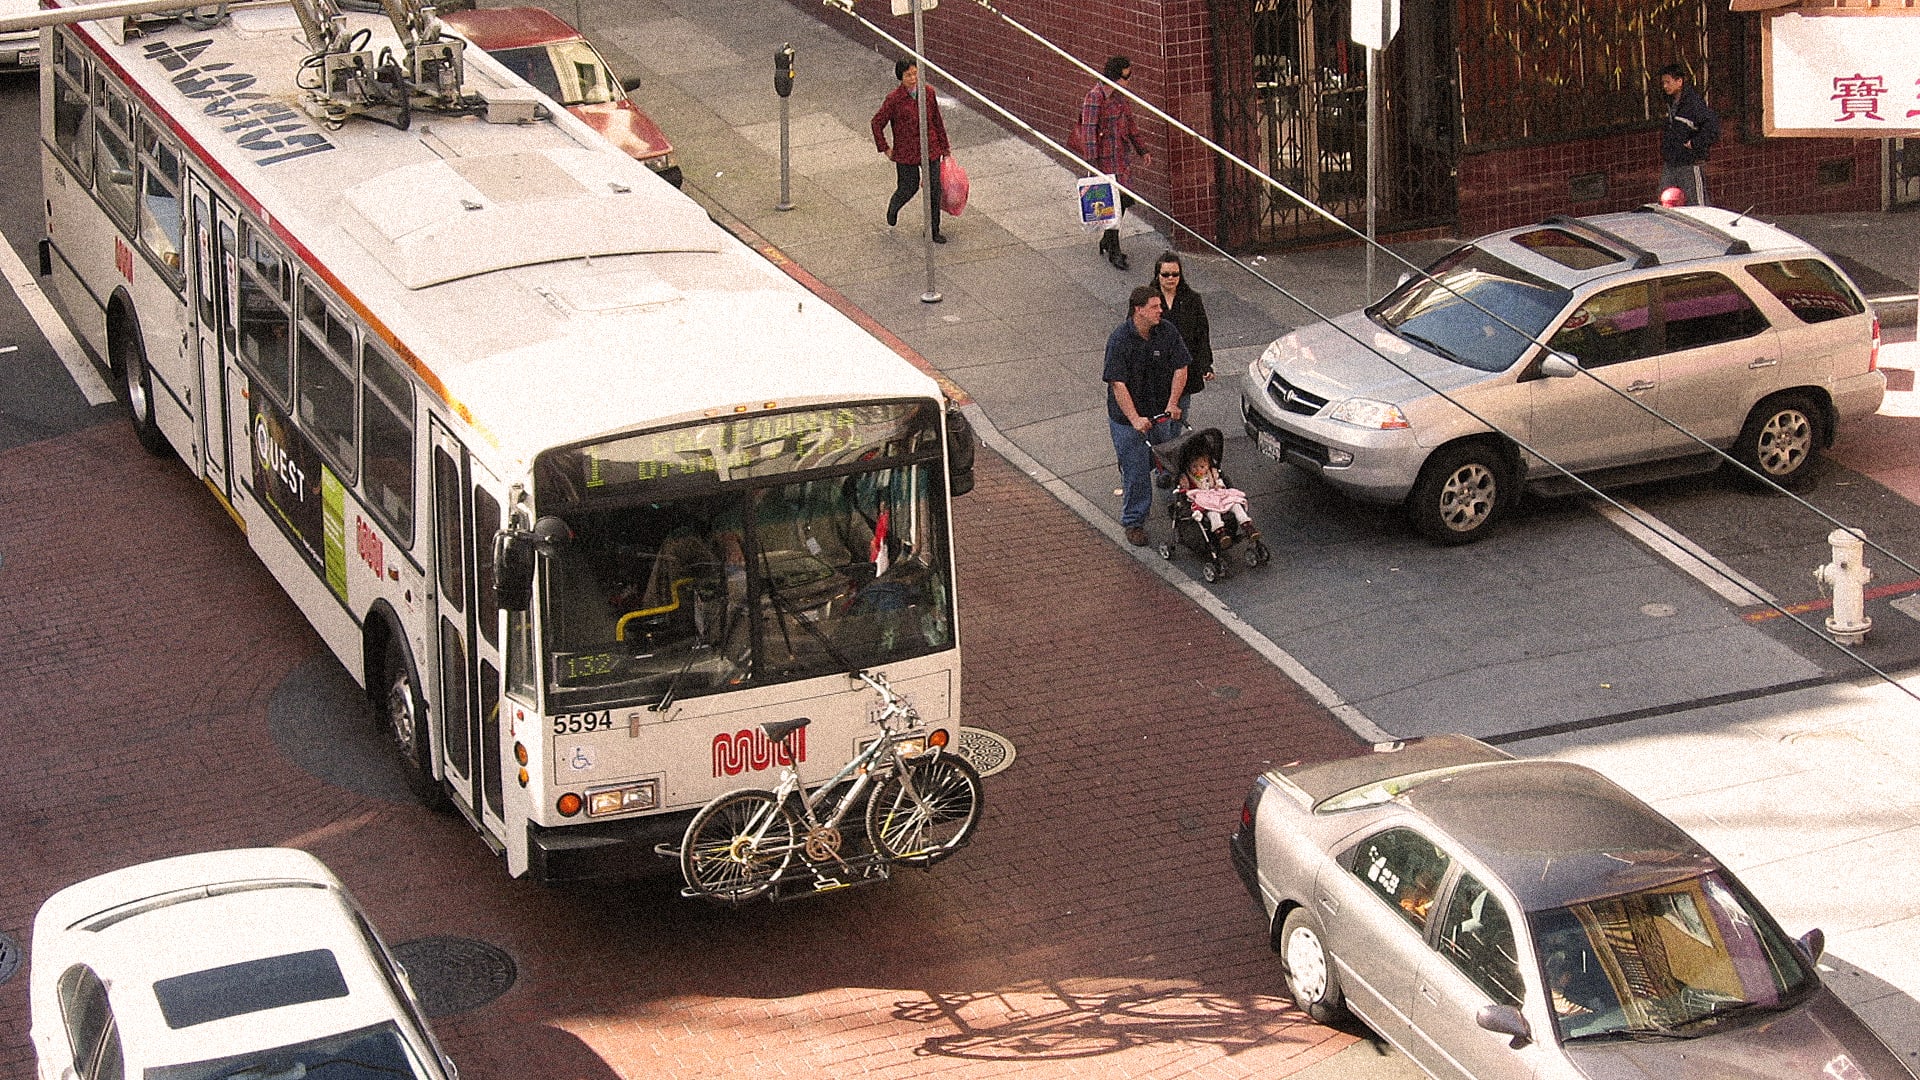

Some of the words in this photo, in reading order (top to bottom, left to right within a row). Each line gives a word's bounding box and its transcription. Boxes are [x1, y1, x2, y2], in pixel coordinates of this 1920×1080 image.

[255, 413, 304, 502] QUEST
[568, 653, 611, 678] 132
[553, 710, 613, 735] 5594
